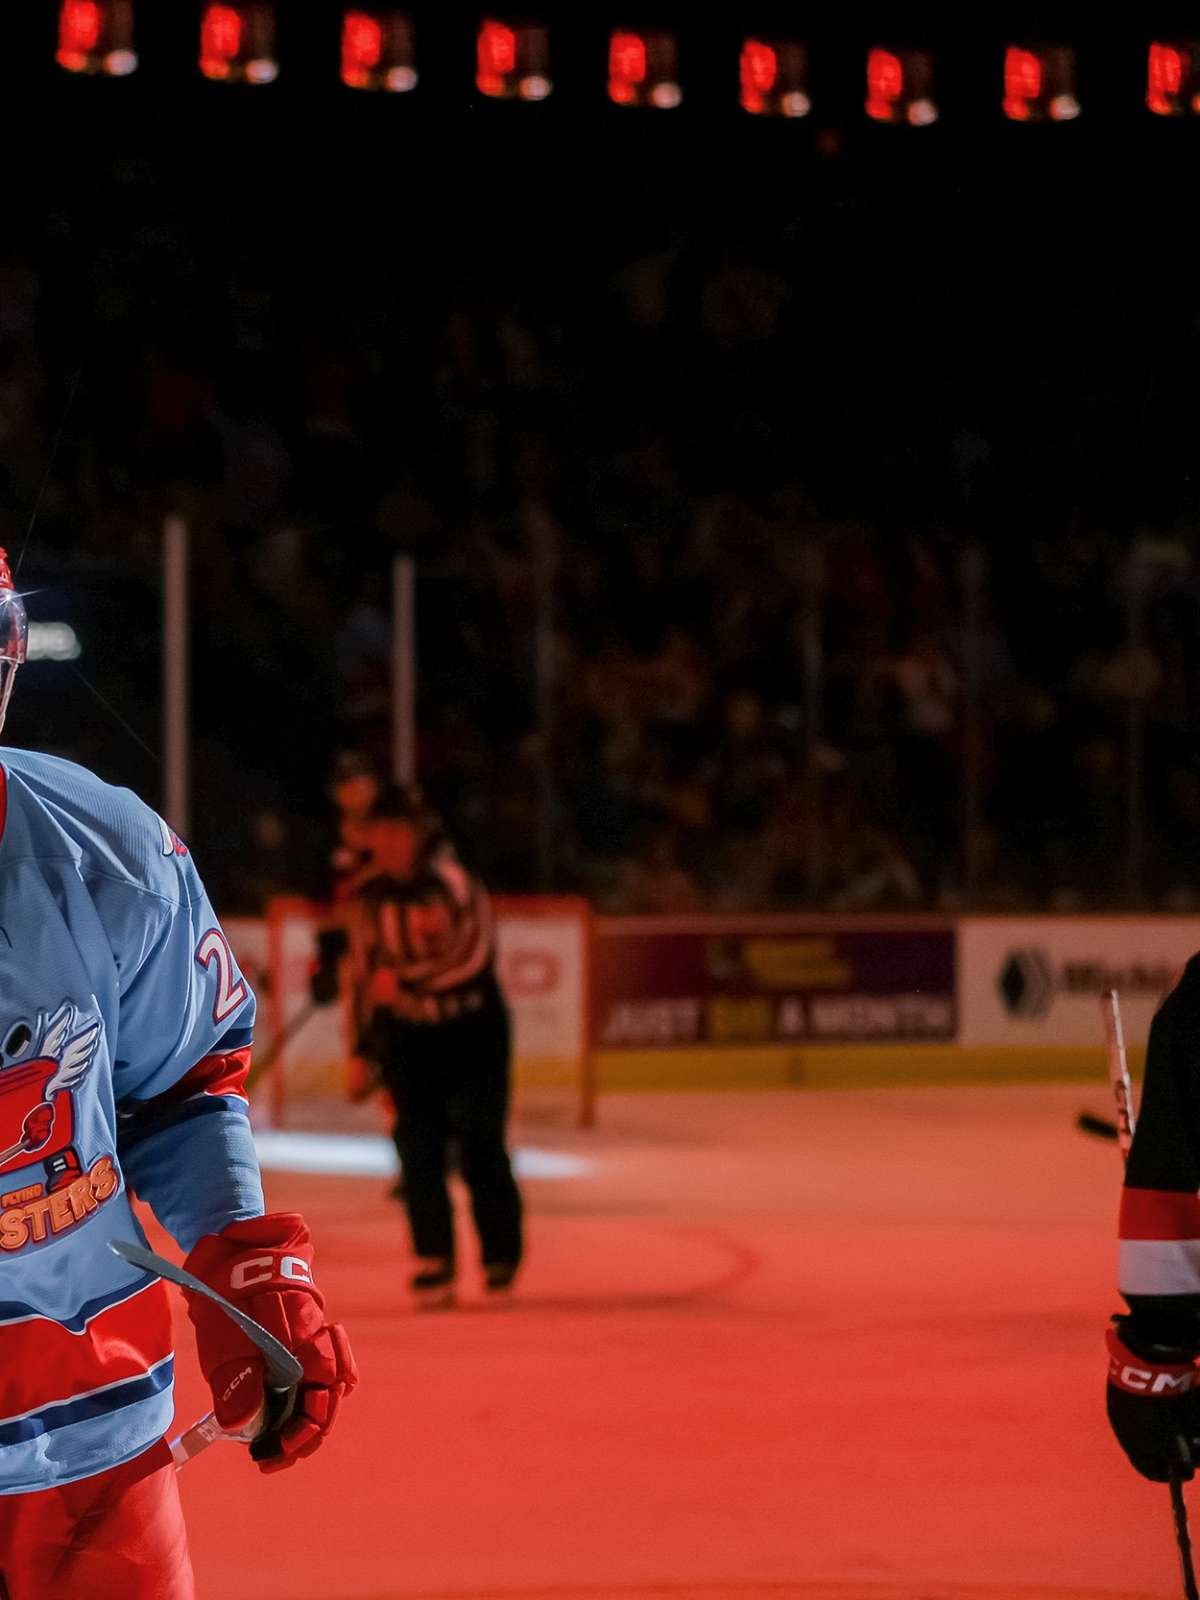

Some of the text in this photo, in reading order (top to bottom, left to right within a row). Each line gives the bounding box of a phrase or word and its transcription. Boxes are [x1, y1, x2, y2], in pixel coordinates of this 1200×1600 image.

[196, 928, 248, 1026] 2
[230, 1255, 314, 1290] CC
[222, 1366, 252, 1402] CCM
[1110, 1356, 1194, 1393] CM
